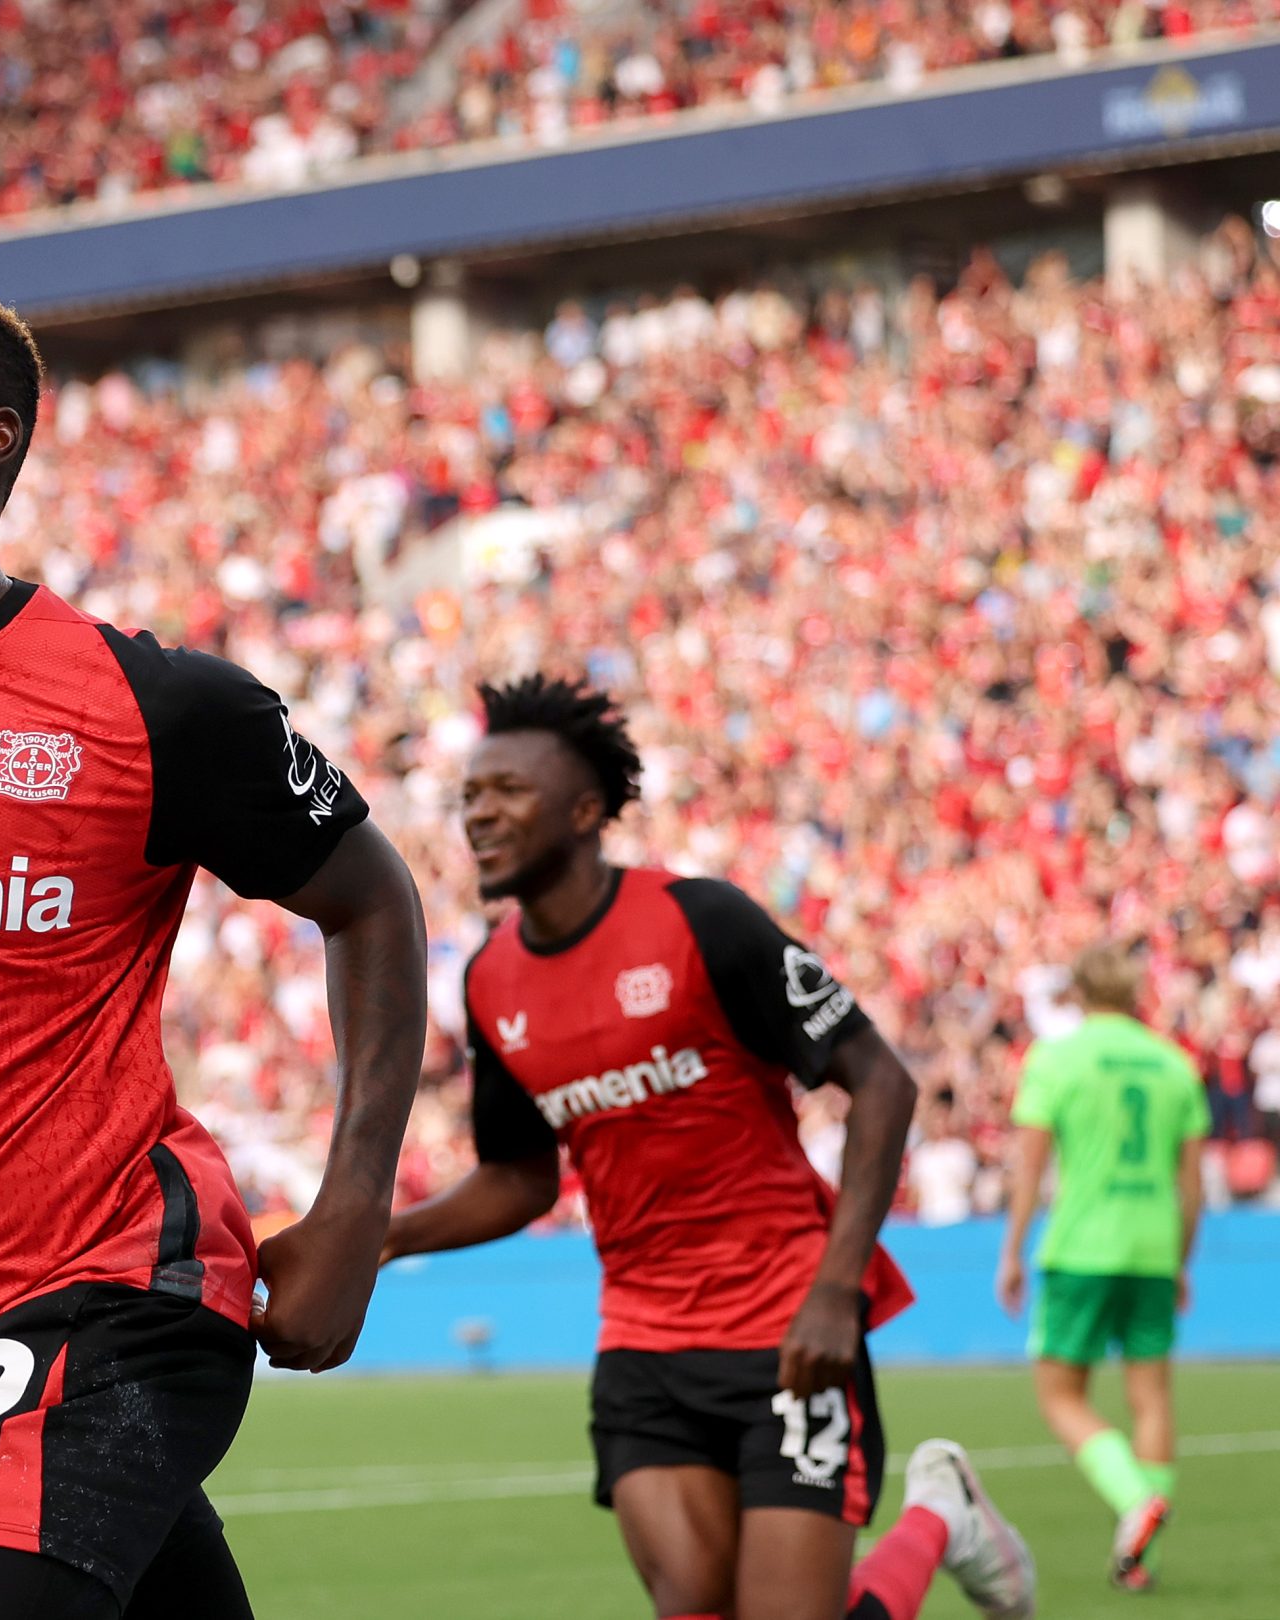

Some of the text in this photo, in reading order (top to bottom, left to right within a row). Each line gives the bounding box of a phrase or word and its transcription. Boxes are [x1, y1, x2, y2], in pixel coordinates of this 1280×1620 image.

[24, 735, 47, 746] 1904
[12, 761, 52, 772] BAYER
[26, 748, 39, 785] BAYER
[533, 1044, 709, 1130] armenia
[770, 1386, 851, 1466] 12
